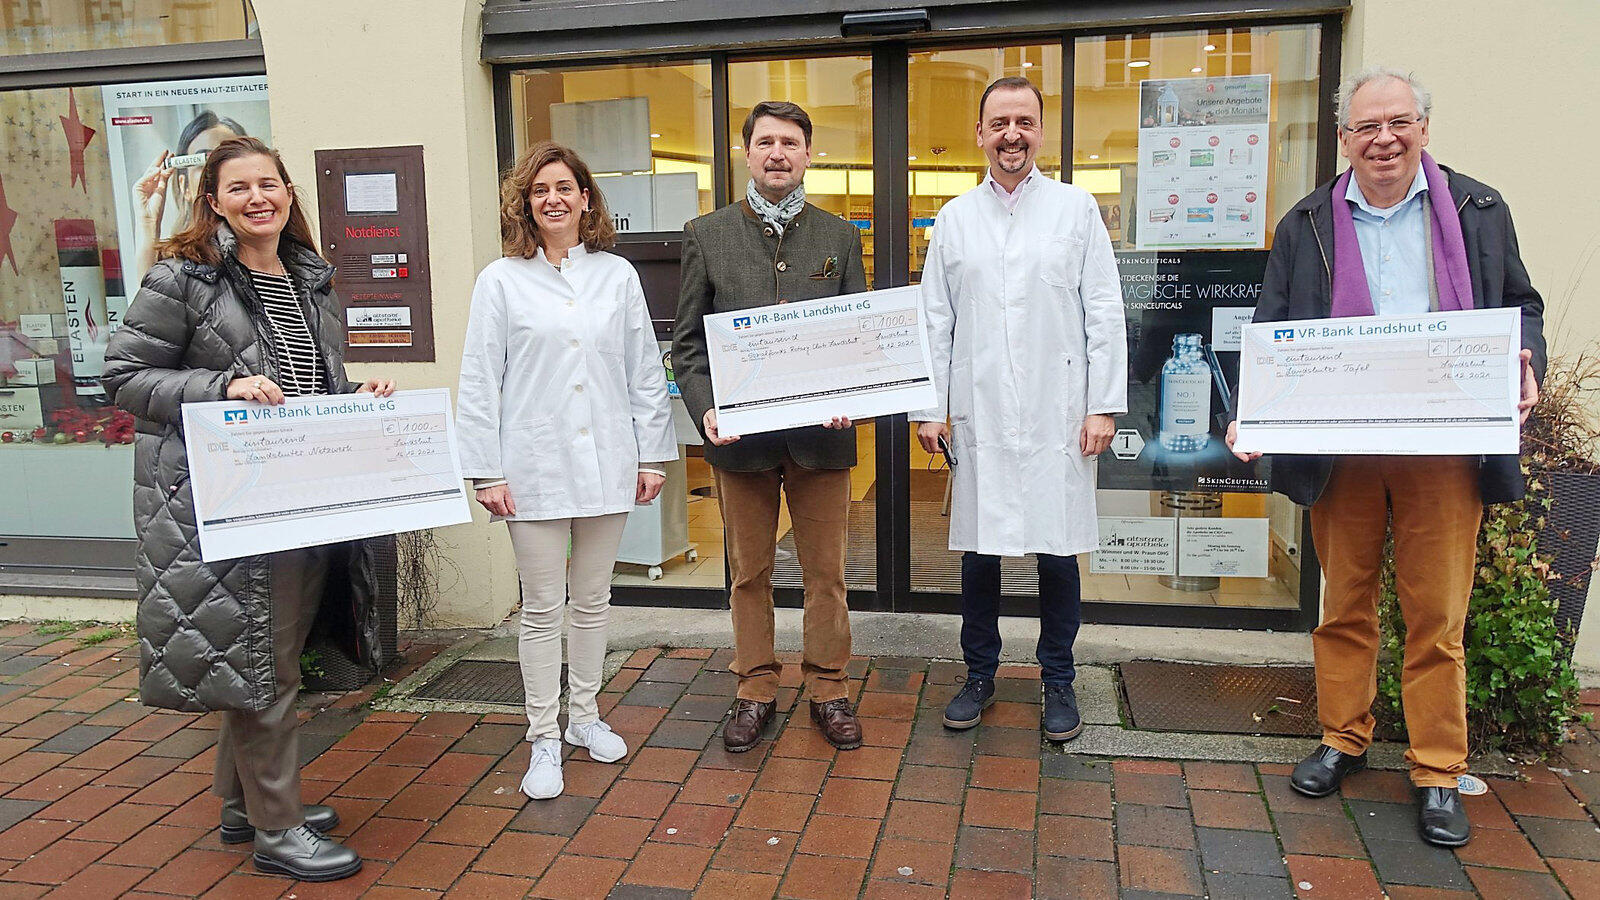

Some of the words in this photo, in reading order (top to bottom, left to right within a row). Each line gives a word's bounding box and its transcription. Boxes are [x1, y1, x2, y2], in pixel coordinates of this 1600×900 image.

[171, 88, 199, 96] NEUES
[200, 84, 268, 94] HAUT-ZEITALTER
[1196, 98, 1224, 106] Unsere
[1226, 97, 1262, 105] Angebote
[1232, 107, 1262, 115] Monats!
[613, 213, 630, 231] in
[345, 226, 401, 239] Notdienst
[1120, 274, 1155, 282] NTDECKEN
[1156, 274, 1166, 282] SIE
[1168, 274, 1179, 282] DIE
[1121, 284, 1192, 299] MAGISCHE
[1196, 284, 1263, 299] WIRKKRAF
[753, 310, 800, 325] VR-Bank
[803, 304, 852, 318] Landshut
[856, 300, 871, 310] eG
[1131, 302, 1183, 310] SKINCEUTICALS
[64, 281, 84, 364] ELASTEN
[1298, 326, 1354, 339] VR-Bank
[1359, 323, 1422, 335] Landshut
[1428, 321, 1447, 332] eG
[252, 406, 312, 420] VR-Bank
[316, 402, 374, 416] Landshut
[380, 400, 396, 411] eG
